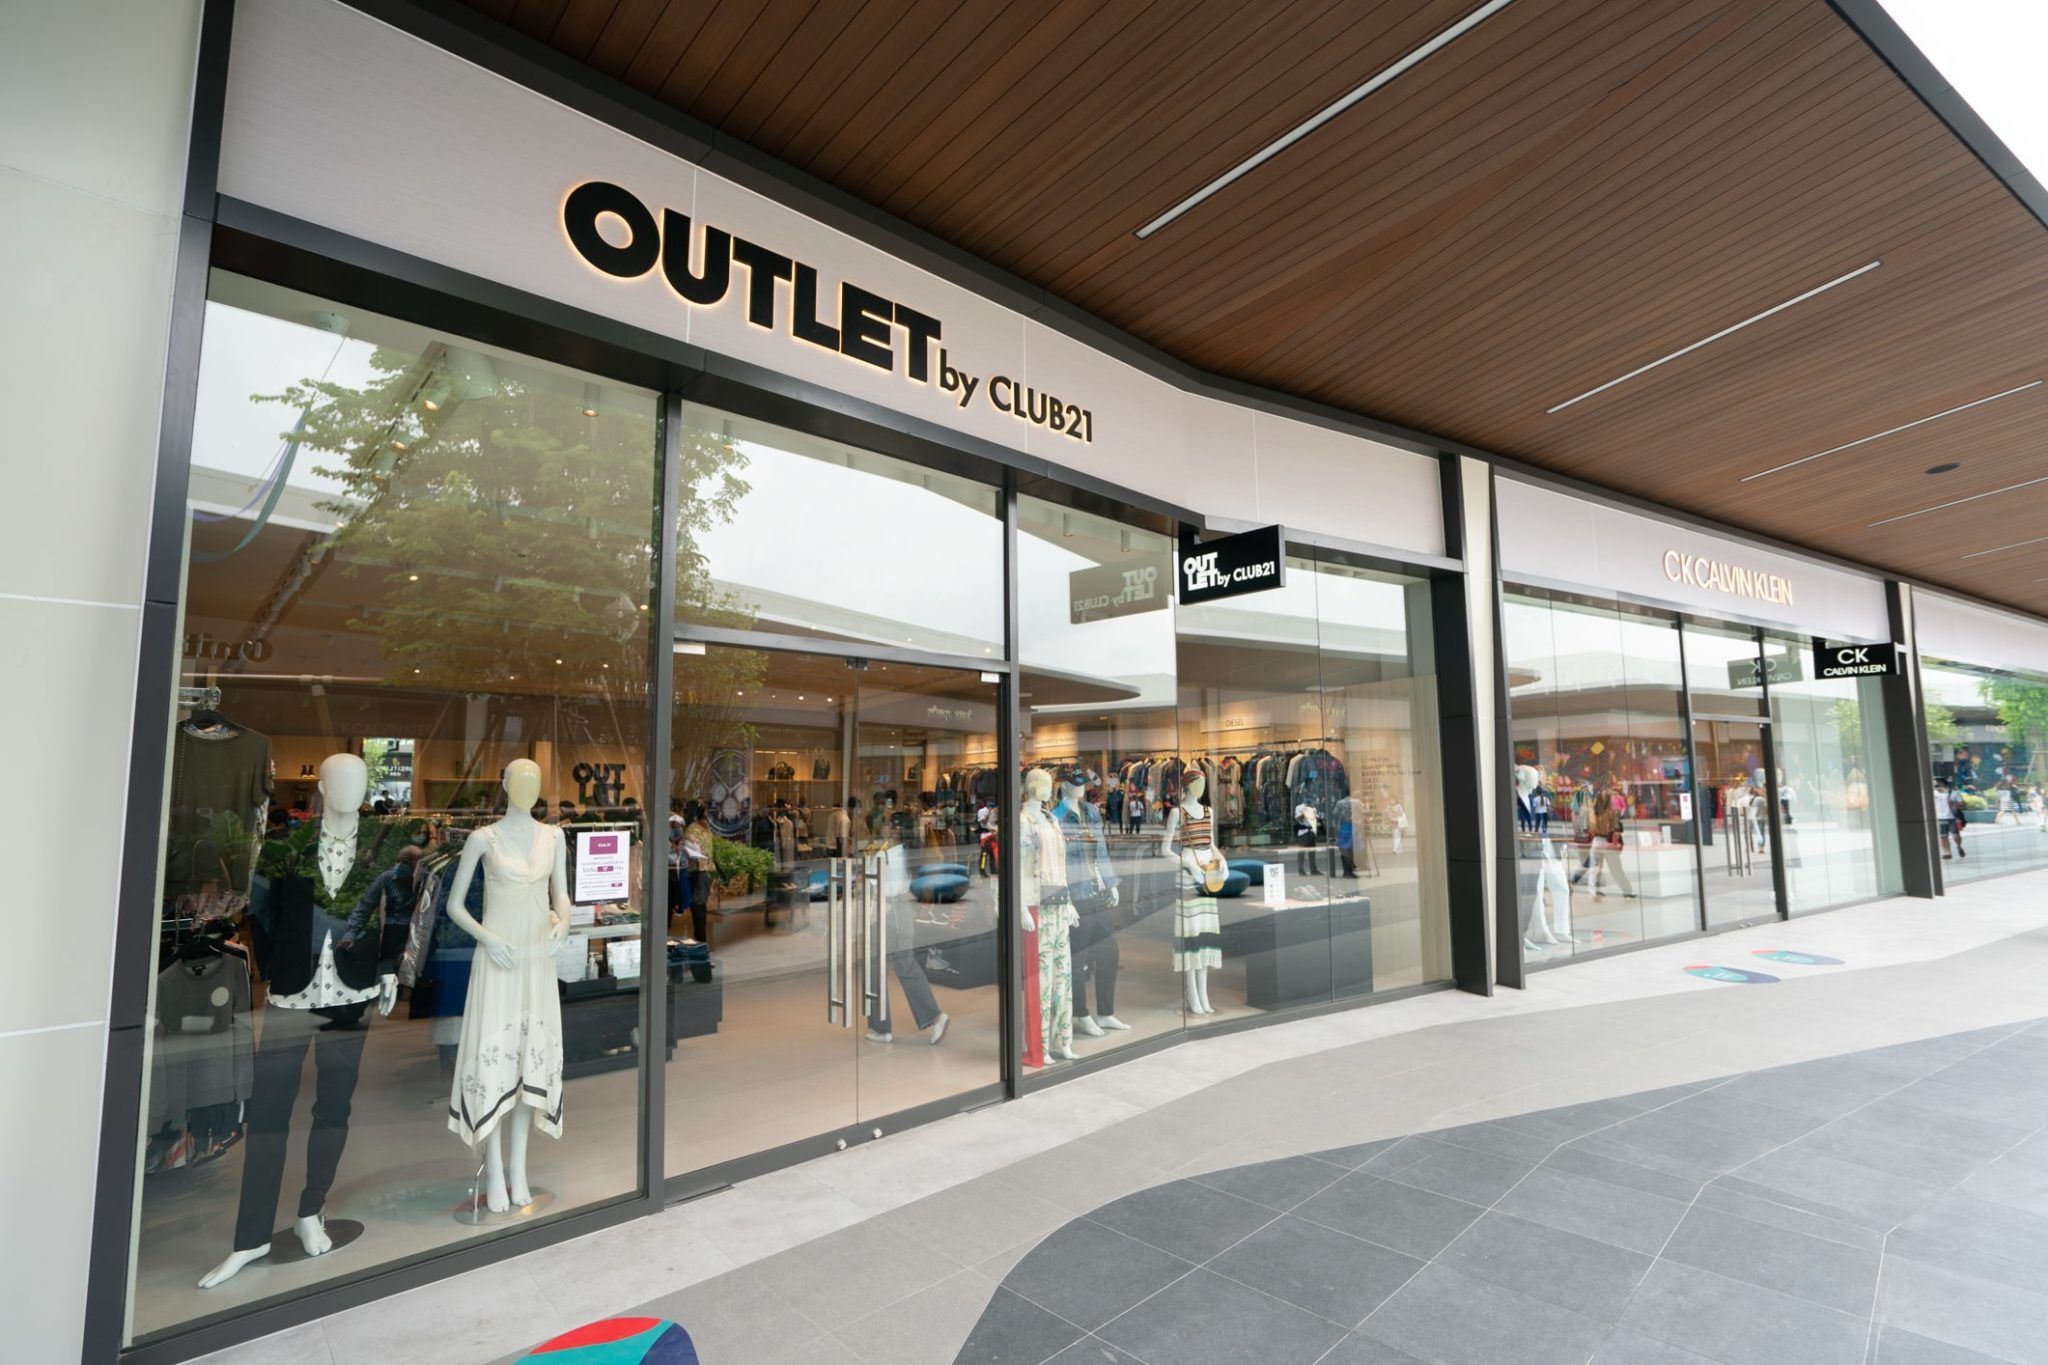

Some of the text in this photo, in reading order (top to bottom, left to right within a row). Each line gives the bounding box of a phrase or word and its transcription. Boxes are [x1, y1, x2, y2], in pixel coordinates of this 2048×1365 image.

[562, 181, 1093, 443] OUTLET by CLUB21
[1183, 551, 1218, 575] OUT
[1187, 560, 1276, 592] LET by CLUB21
[1663, 550, 1794, 606] CK CALVIN KLEIN
[1837, 647, 1869, 664] CK
[1823, 664, 1887, 676] CALVIN KLEIN
[1225, 718, 1244, 728] DIESEL
[572, 762, 626, 785] OUT
